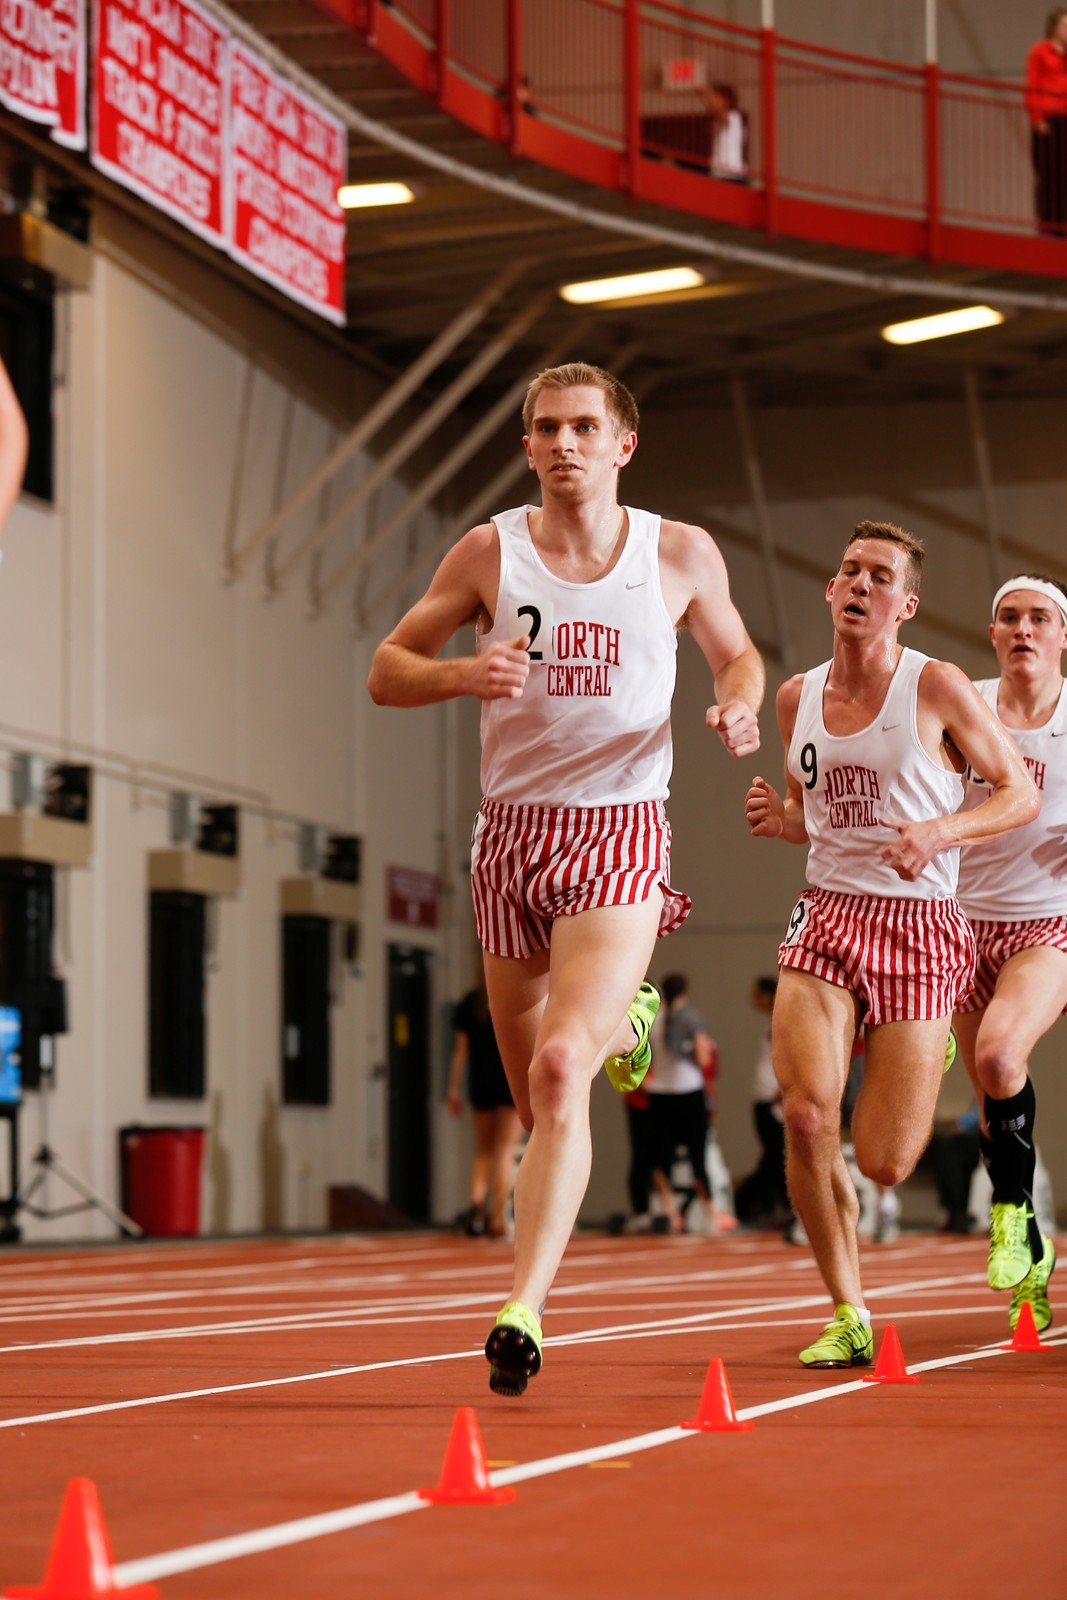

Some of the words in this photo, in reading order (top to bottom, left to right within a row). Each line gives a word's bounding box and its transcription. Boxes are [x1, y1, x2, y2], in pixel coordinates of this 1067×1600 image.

[517, 605, 543, 660] 2
[552, 621, 621, 666] ORTH
[547, 665, 612, 696] CENTRAL
[800, 743, 818, 790] 9
[829, 801, 878, 829] CENTRAL
